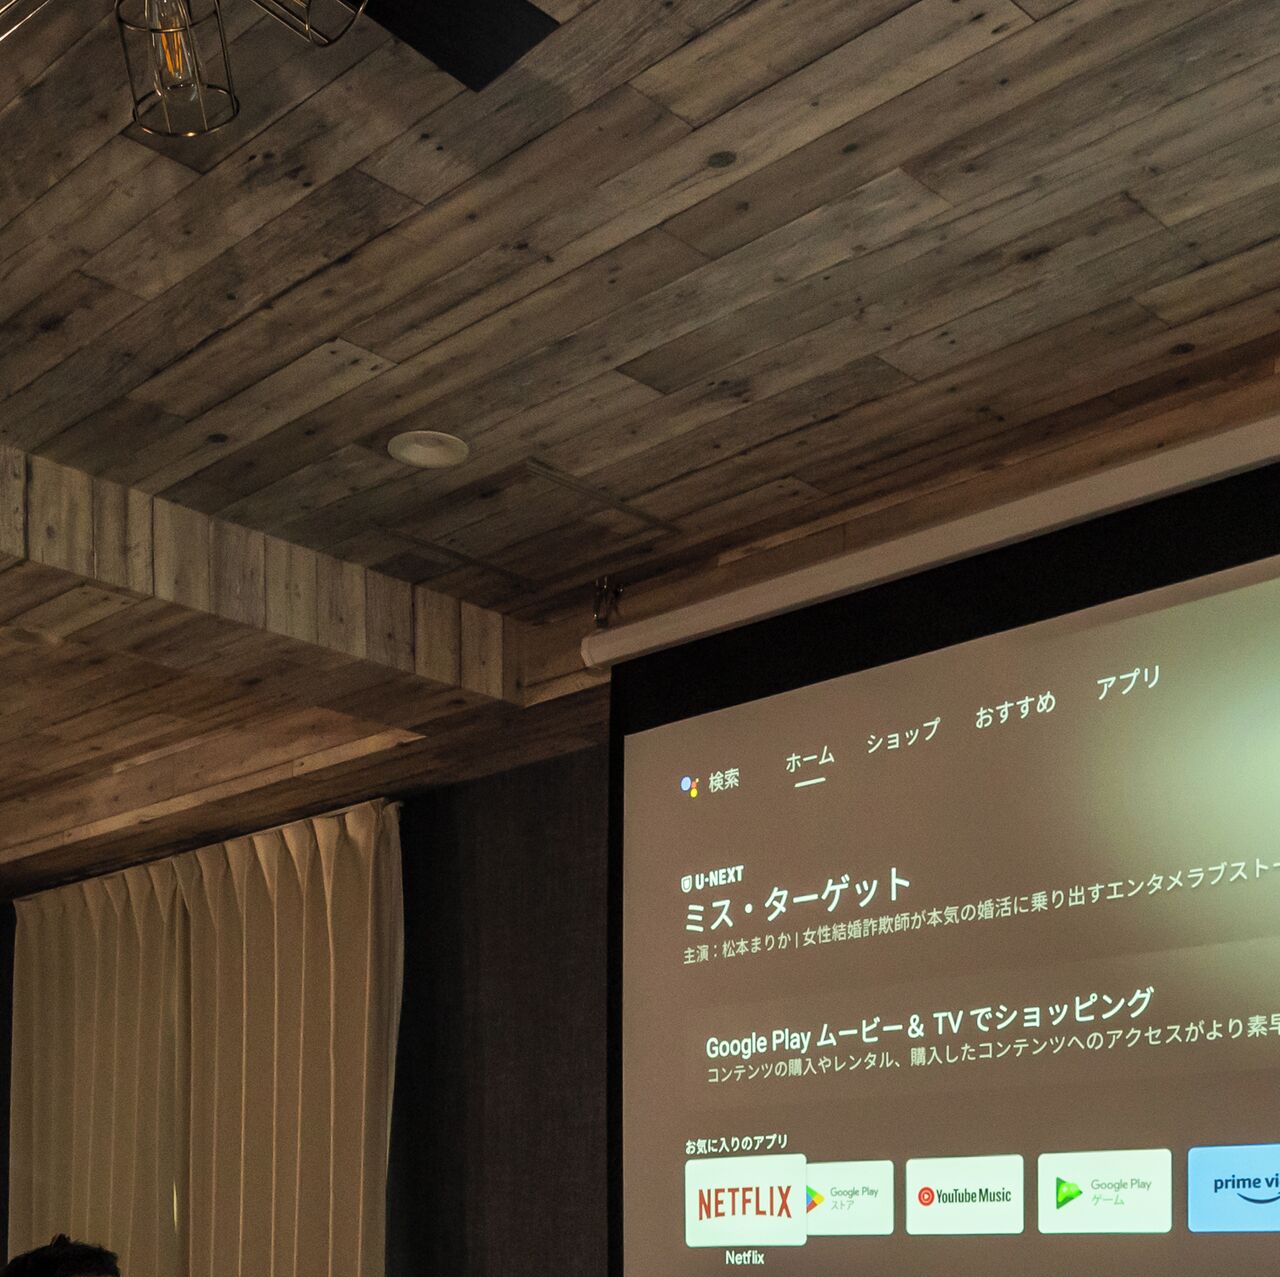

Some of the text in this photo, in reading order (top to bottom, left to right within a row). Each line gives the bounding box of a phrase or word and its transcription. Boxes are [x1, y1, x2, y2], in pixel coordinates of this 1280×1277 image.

[1097, 664, 1160, 701] アプリ
[975, 690, 1057, 729] おすすめ
[867, 716, 942, 754] ショップ
[786, 745, 836, 773] ホーム
[708, 767, 740, 793] 検索
[685, 866, 911, 933] ミス・ターゲット
[705, 1031, 768, 1062] Google
[772, 1027, 812, 1054] Play
[933, 1009, 965, 1036] TV
[969, 985, 1156, 1033] でショッピング
[685, 1134, 789, 1155] お気に入りのアプリ
[830, 1186, 880, 1199] Google Play
[936, 1186, 1012, 1205] YouTube Music
[1091, 1178, 1152, 1192] Google Play
[1213, 1174, 1262, 1194] prime
[698, 1185, 793, 1221] NETFLIX
[831, 1200, 855, 1212] ストア
[1091, 1193, 1125, 1206] ゲーム
[725, 1250, 766, 1266] Netflix
